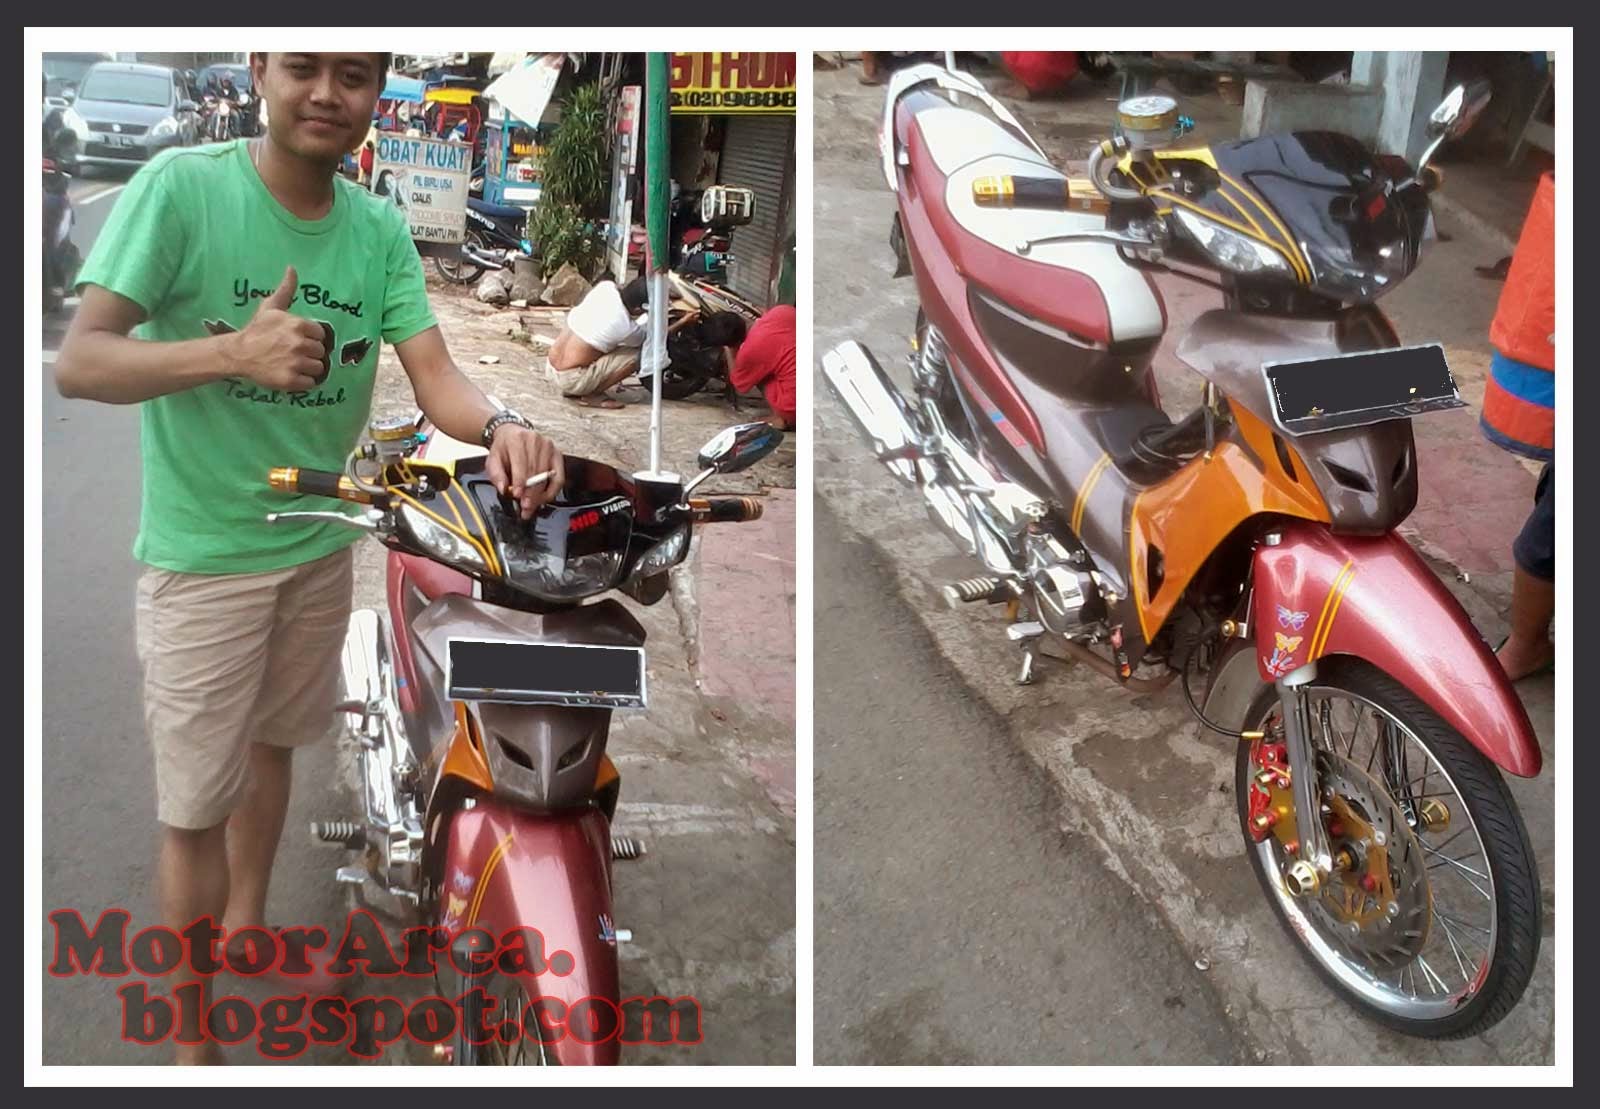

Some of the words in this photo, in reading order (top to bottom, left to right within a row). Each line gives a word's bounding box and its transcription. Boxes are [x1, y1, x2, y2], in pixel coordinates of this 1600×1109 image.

[379, 138, 420, 164] OBAT
[425, 142, 467, 169] KUAT
[300, 283, 364, 318] Blood
[223, 378, 281, 404] Total
[286, 386, 347, 409] Rebel
